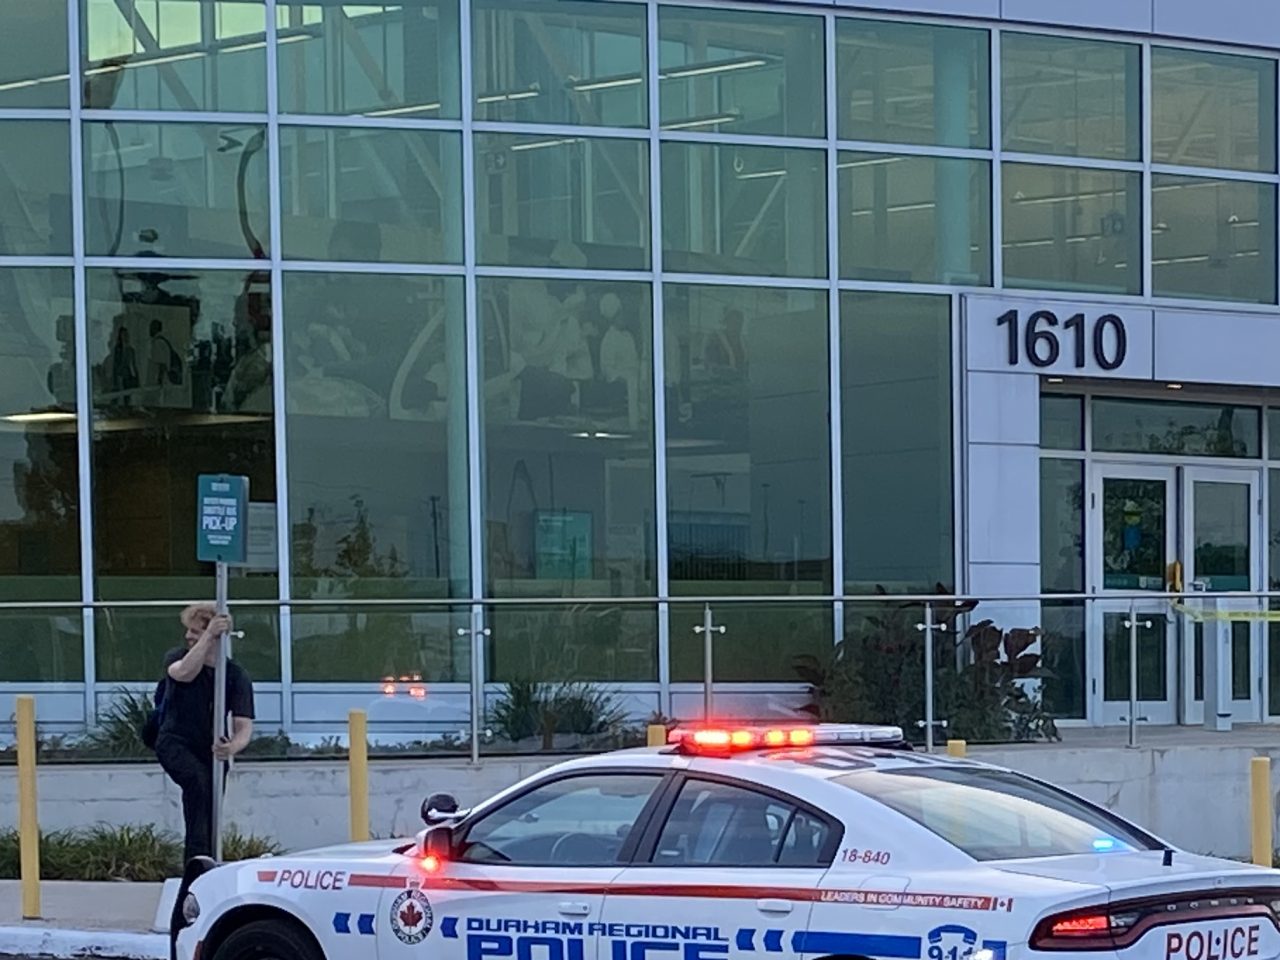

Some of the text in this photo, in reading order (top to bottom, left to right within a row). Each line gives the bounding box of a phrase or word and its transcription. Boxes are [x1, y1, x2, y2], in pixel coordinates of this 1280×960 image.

[996, 309, 1127, 370] 1610
[203, 516, 237, 531] PICK-UP
[842, 849, 890, 865] 18-840
[277, 870, 346, 890] POLICE
[821, 890, 865, 903] LEADERS
[866, 893, 877, 903] IN
[943, 896, 984, 909] SAFETY
[466, 918, 730, 941] DURHAM REGIONAL
